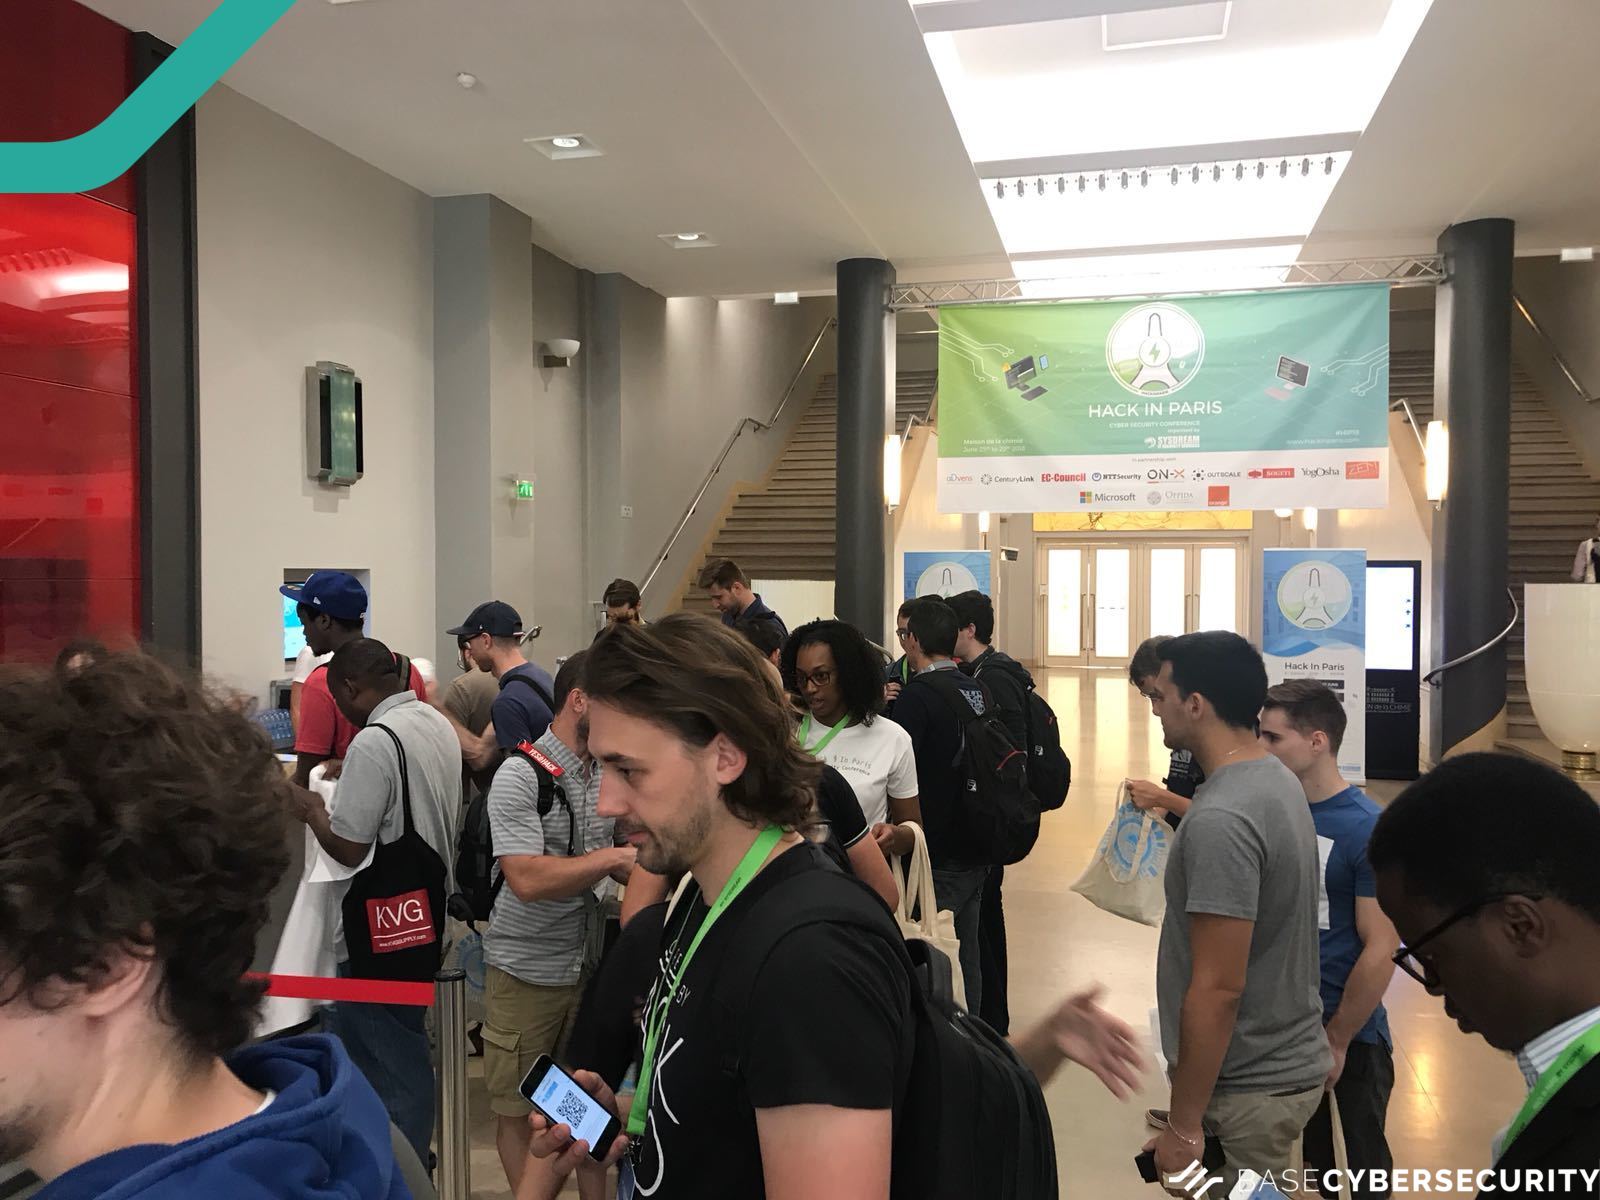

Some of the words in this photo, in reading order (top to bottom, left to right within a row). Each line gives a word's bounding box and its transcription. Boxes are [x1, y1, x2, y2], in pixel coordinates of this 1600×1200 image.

[1088, 402, 1139, 418] HACK
[1145, 402, 1163, 416] IN
[1169, 400, 1223, 415] PARIS
[1041, 472, 1086, 482] EC-Council
[1147, 468, 1185, 479] ON-X
[994, 475, 1034, 484] CenturyLink
[1094, 492, 1136, 502] Microsoft
[1284, 662, 1309, 670] Hack
[1310, 662, 1319, 670] In
[1322, 662, 1345, 671] Paris
[376, 899, 424, 929] KVG
